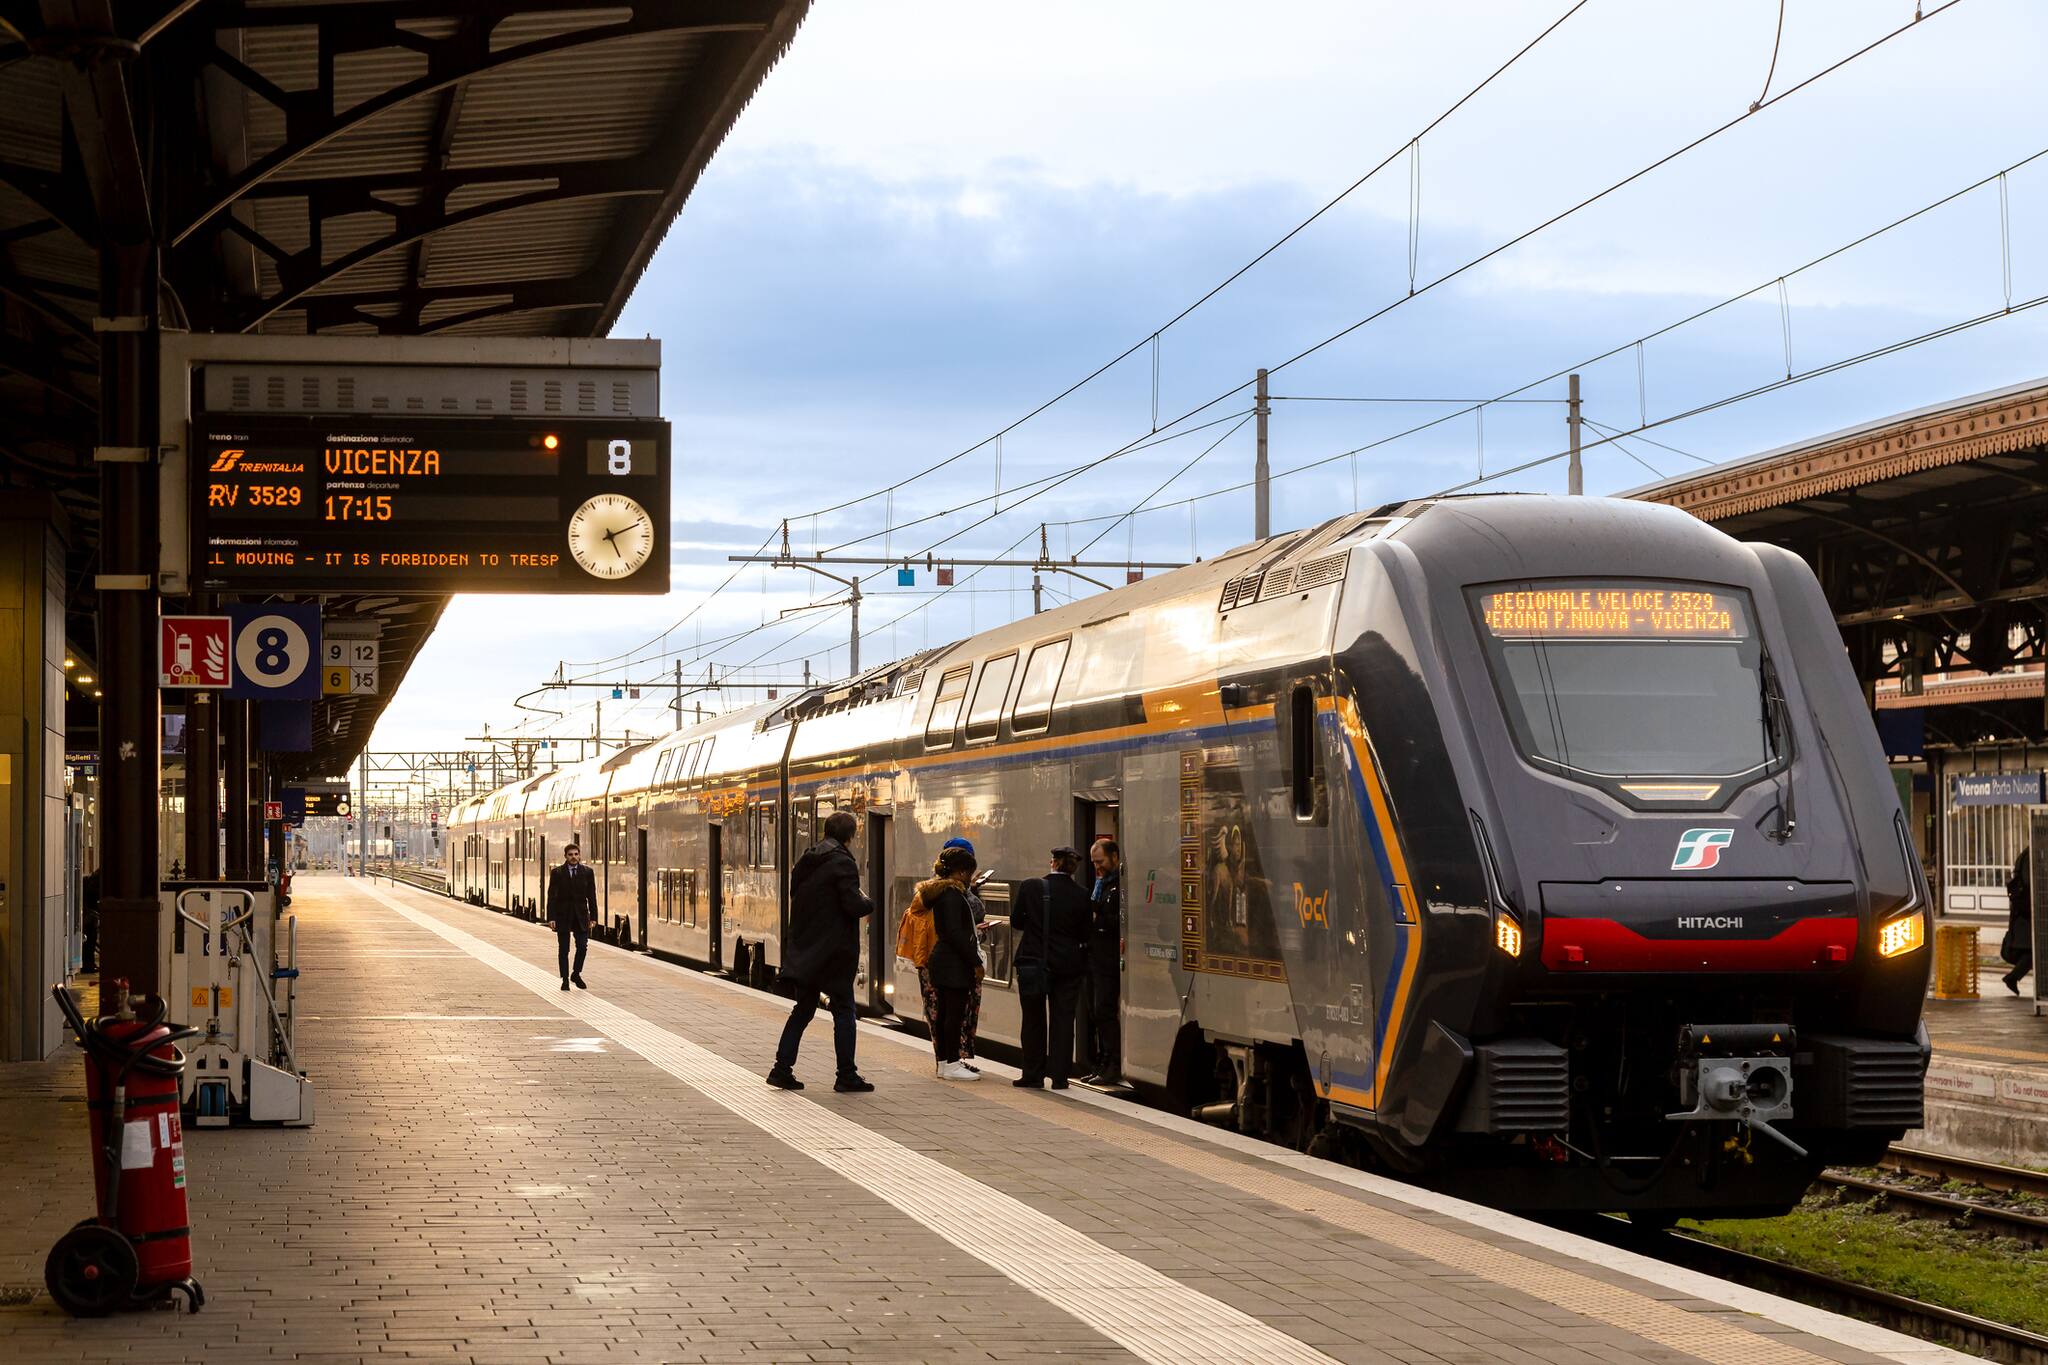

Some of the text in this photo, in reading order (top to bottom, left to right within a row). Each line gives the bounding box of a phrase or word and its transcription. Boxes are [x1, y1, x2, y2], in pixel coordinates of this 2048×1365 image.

[209, 433, 232, 441] treno
[326, 433, 415, 443] destinazione destination
[325, 449, 440, 475] VICENZA
[608, 440, 631, 475] 8
[239, 463, 304, 472] TRENITALIA
[326, 481, 400, 490] partenza departure
[208, 484, 302, 507] RV 3529
[325, 495, 392, 521] 17:15
[208, 536, 299, 546] informazioni information
[208, 553, 225, 565] L
[236, 552, 295, 566] MOVING
[325, 553, 342, 566] IT
[353, 553, 371, 566] IS
[380, 553, 469, 566] FORBIDDEN
[480, 553, 499, 566] TO
[510, 554, 559, 566] TRESP
[1493, 592, 1713, 610] REGIONALE VELOCE 3529
[1651, 612, 1731, 629] VICENZA
[255, 627, 291, 675] 8
[330, 645, 374, 661] 9 12
[330, 672, 374, 687] 6 15
[1959, 778, 2039, 796] Verona Porta Nuova
[1677, 917, 1743, 929] HITACHI
[2013, 1082, 2022, 1095] Do
[2023, 1085, 2033, 1097] not
